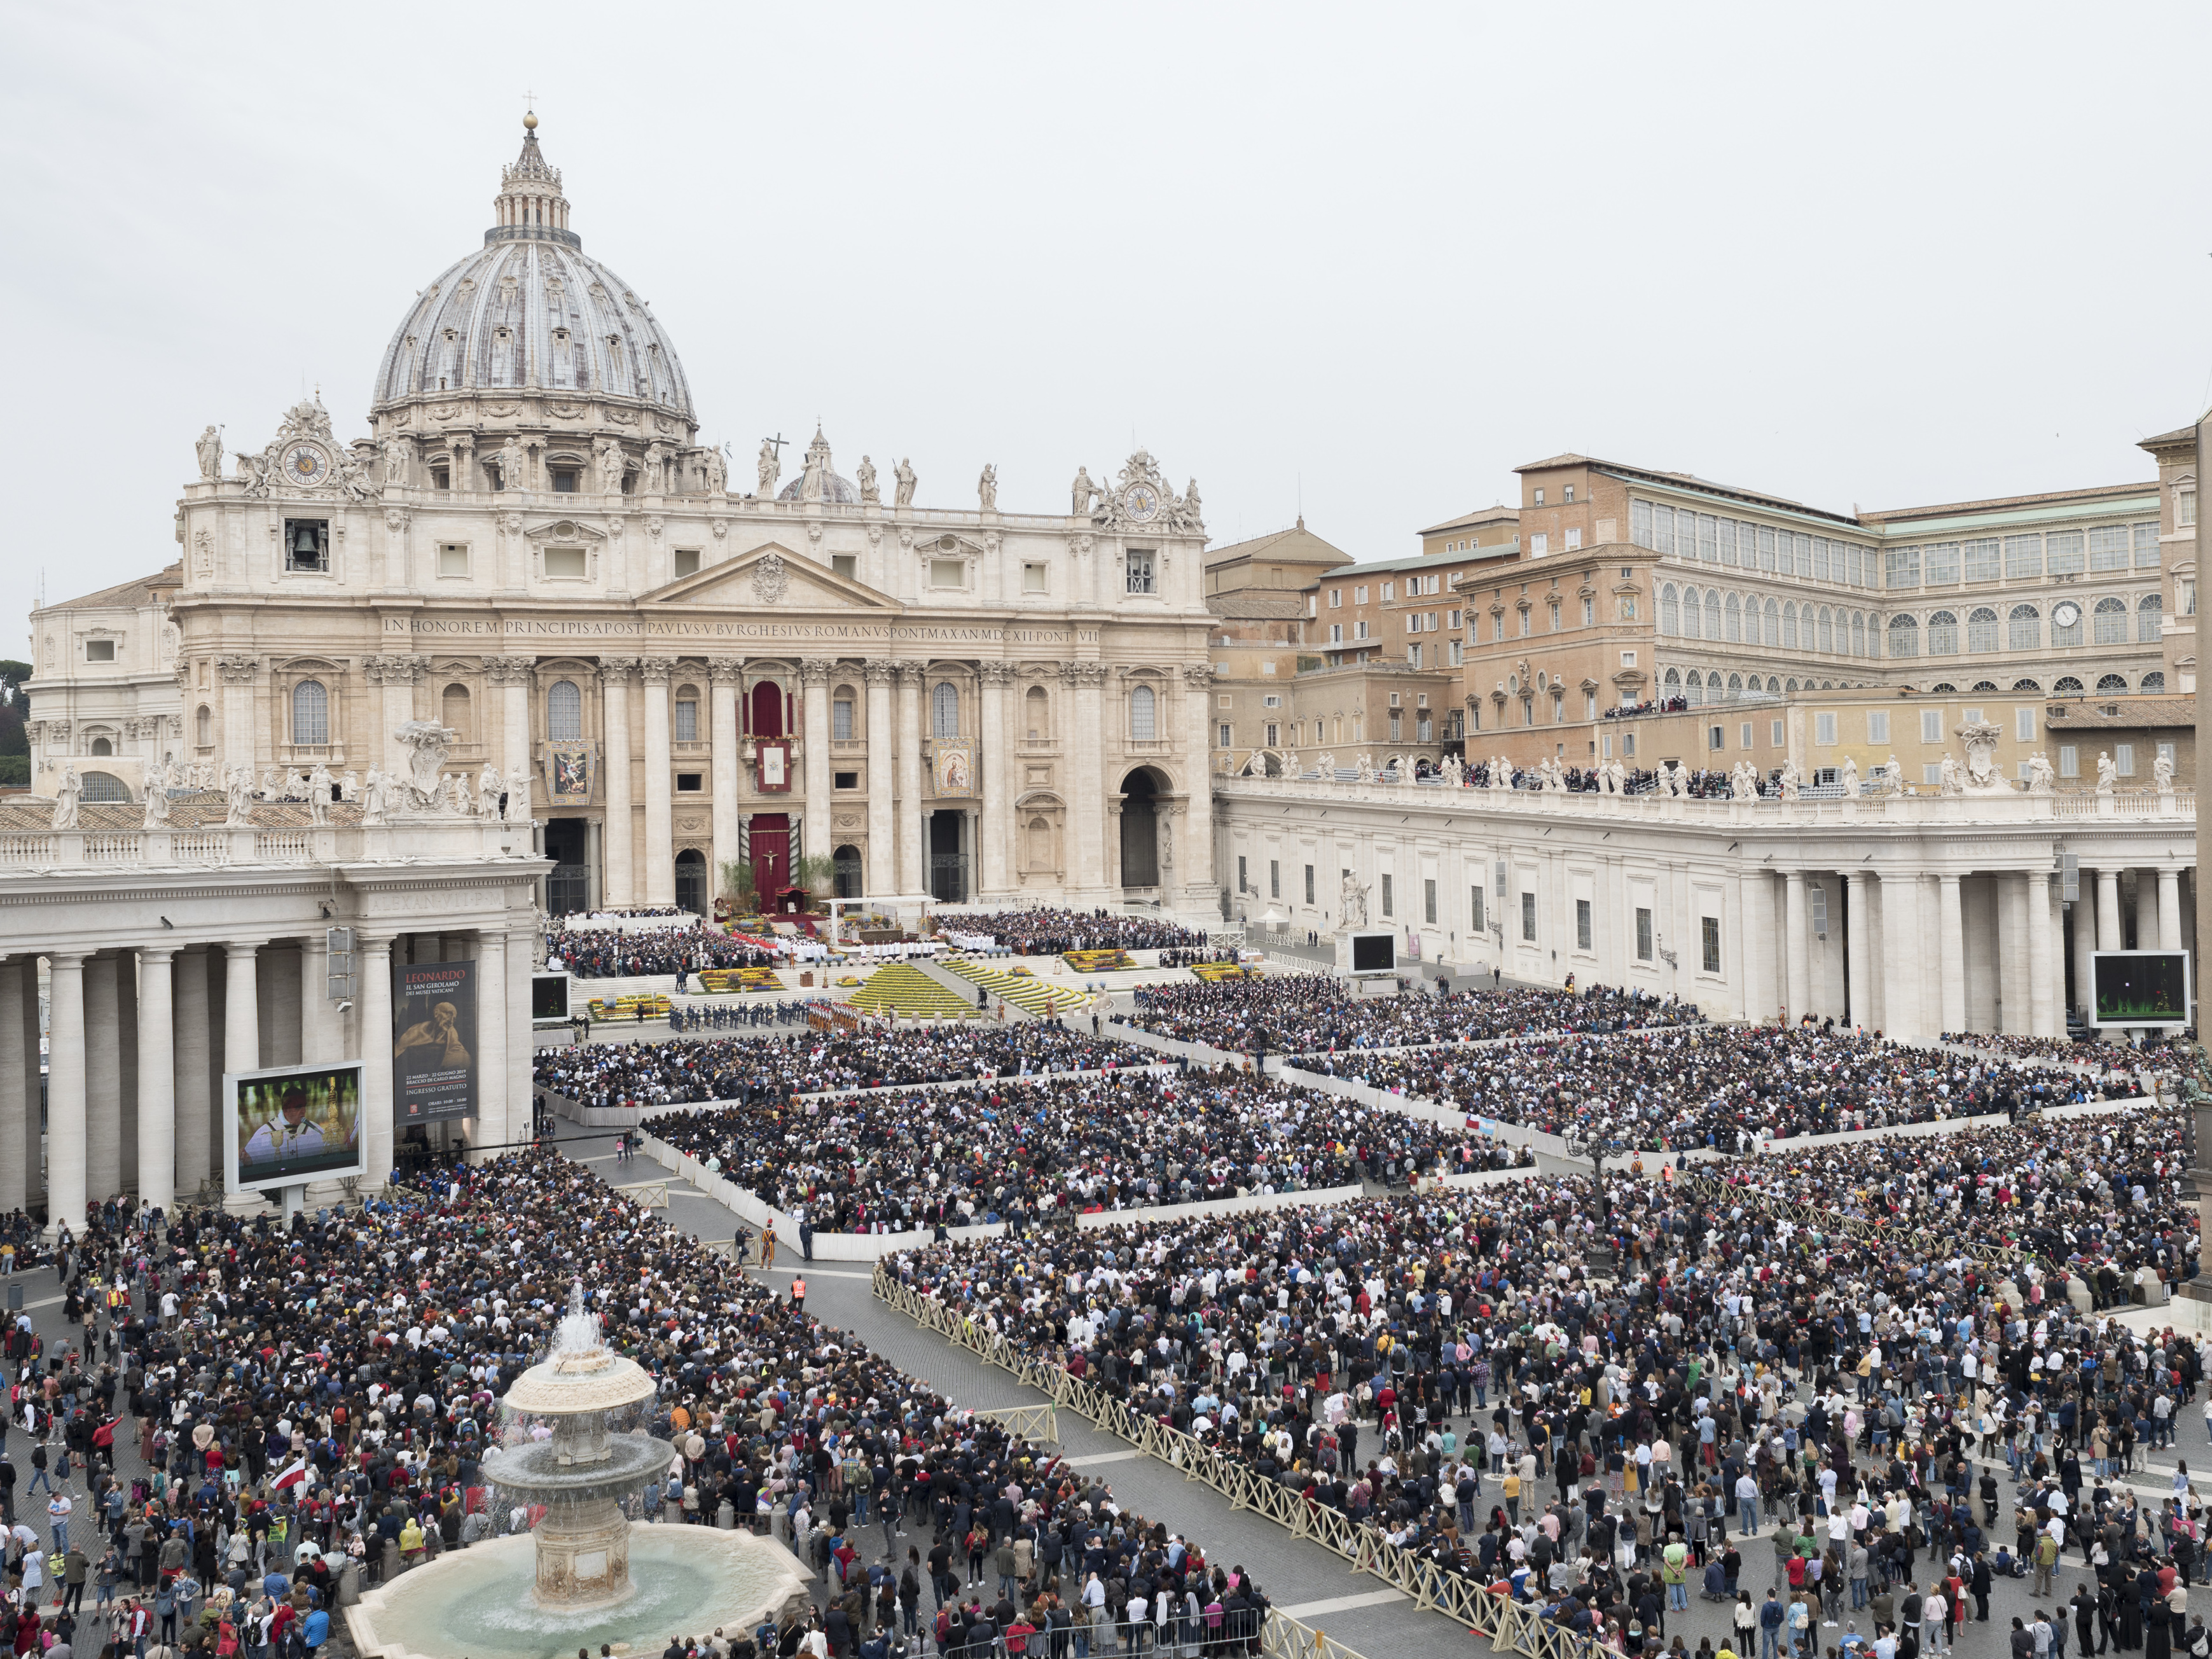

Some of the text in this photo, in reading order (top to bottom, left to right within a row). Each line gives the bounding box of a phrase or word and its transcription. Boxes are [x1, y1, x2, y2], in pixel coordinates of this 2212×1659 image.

[384, 619, 1098, 642] IN HONOREM PRINCIPIS APOST PAVLVS V BVRGHESIVS ROMANVS PONT MAX AN MDCXII PONT VII
[371, 894, 435, 911] ALEXAN
[444, 892, 469, 906] VII
[406, 969, 466, 983] LEONARDO
[426, 980, 459, 989] GIROLAMO
[406, 1083, 467, 1095] INGRESSO GRATUITO
[1885, 1643, 1892, 1655] 3
